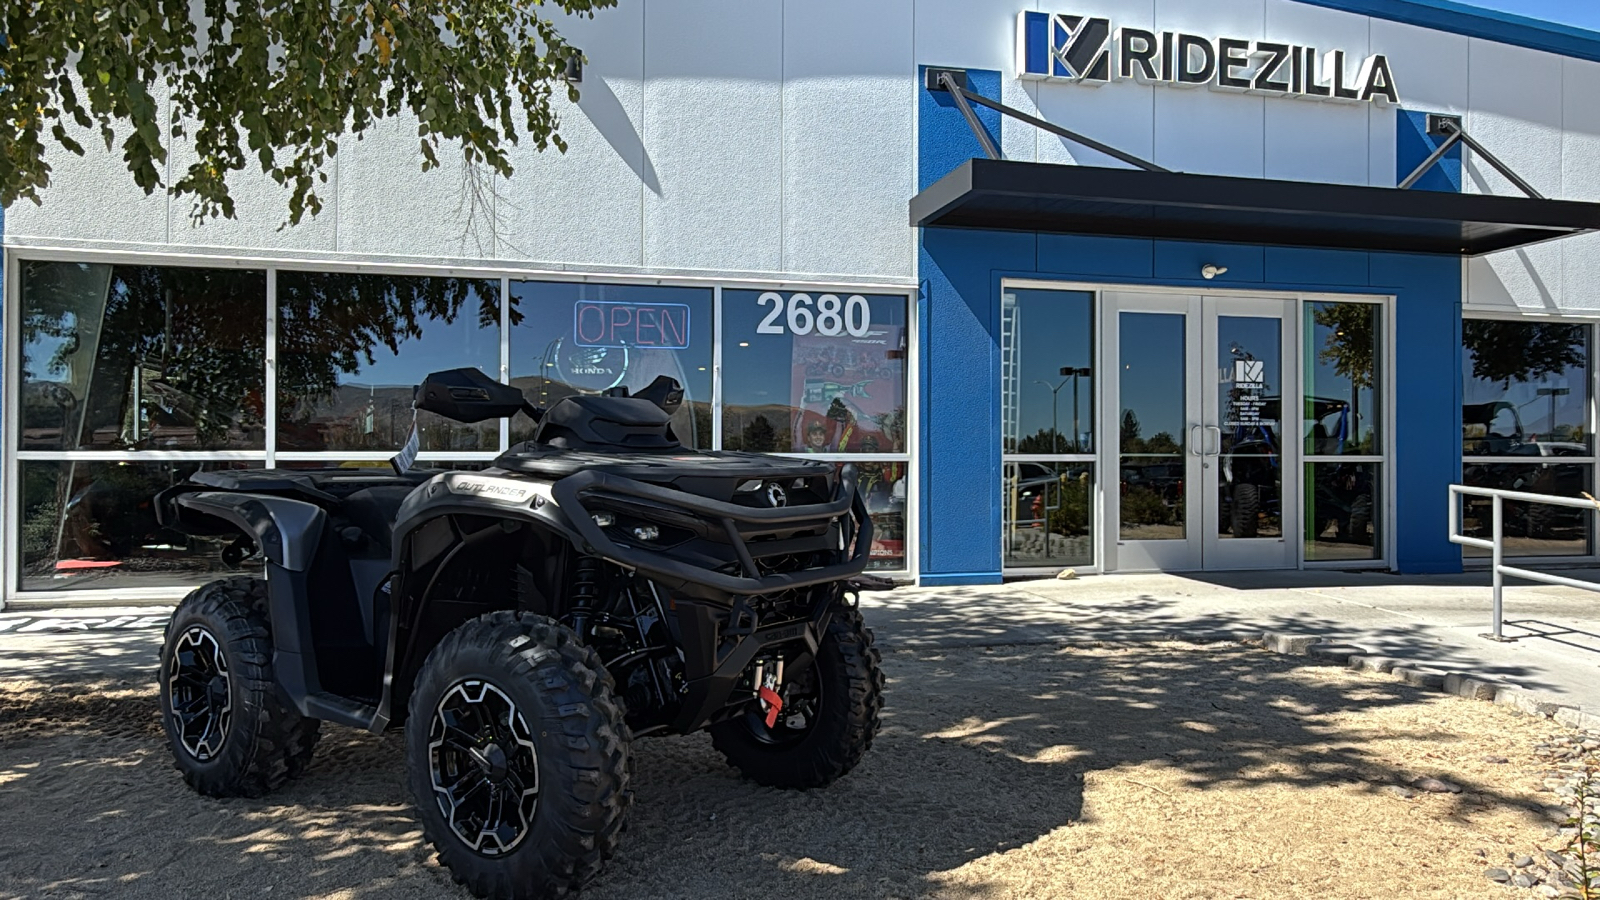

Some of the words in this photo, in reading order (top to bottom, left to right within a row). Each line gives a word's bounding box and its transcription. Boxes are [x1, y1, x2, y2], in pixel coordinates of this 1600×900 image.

[1120, 27, 1400, 104] RIDEZILLA
[578, 305, 686, 346] OPEN
[756, 292, 871, 337] 2680
[571, 367, 613, 375] HONDA
[457, 482, 526, 497] OUTLANDER
